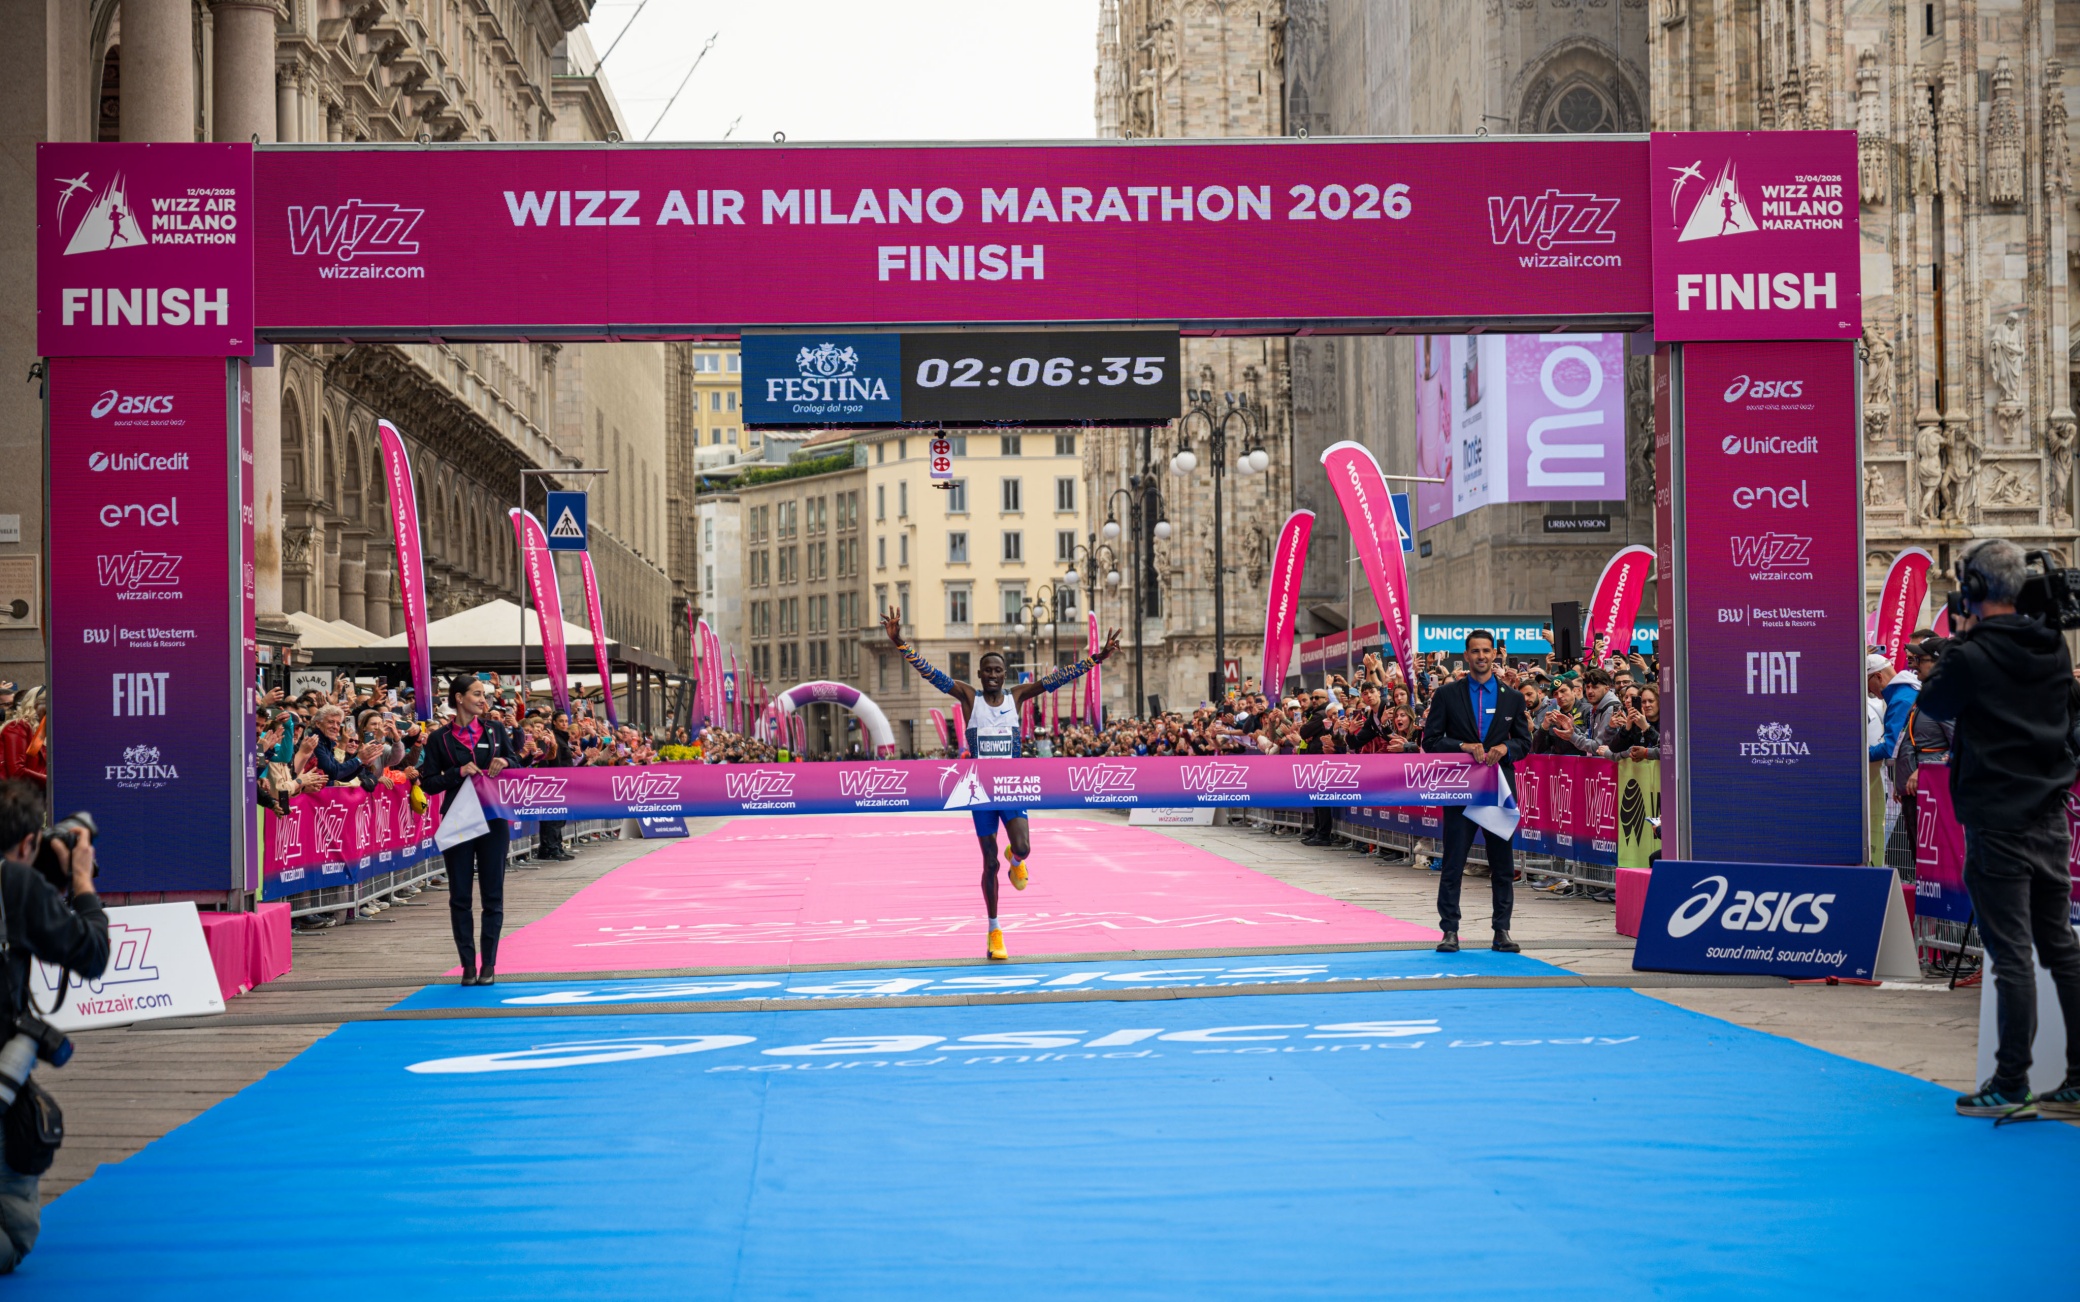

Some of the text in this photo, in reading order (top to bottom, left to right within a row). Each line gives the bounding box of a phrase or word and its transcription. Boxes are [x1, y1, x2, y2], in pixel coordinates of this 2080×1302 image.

[186, 188, 236, 196] 12/04/2026
[1761, 185, 1842, 198] WIZZ AIR
[151, 198, 236, 212] WIZZ AIR
[503, 183, 1412, 226] WIZZ AIR MILANO MARATHON 2026
[1762, 200, 1844, 216] MILANO
[151, 214, 237, 230] MILANO
[1762, 218, 1843, 230] MARATHON
[151, 233, 236, 245] MARATHON
[877, 244, 1044, 282] FINISH
[1518, 252, 1622, 268] wizzair.com
[318, 263, 425, 280] wizzair.com
[1677, 272, 1837, 311] FINISH
[62, 287, 229, 326] FINISH
[915, 356, 1166, 388] 02:06:35
[766, 378, 890, 401] FESTINA
[792, 402, 863, 415] Orologi dal 1902
[1526, 333, 1605, 487] mo
[1743, 436, 1819, 454] UniCredit
[111, 452, 190, 471] UniCredit
[1733, 479, 1809, 509] enel
[100, 496, 180, 527] enel
[1548, 519, 1606, 529] URBAN VISION
[1285, 525, 1301, 592] MARATHON
[1749, 571, 1814, 581] wizzair.com
[116, 590, 183, 601] wizzair.com
[1604, 563, 1631, 635] MARATHON
[1893, 565, 1912, 636] MARATHON
[1718, 608, 1743, 623] BW
[1753, 608, 1778, 619] Best
[83, 628, 110, 643] BW
[120, 628, 146, 640] Best
[1424, 627, 1510, 641] UNICRDIT
[1746, 651, 1801, 695] FIAT
[296, 675, 327, 687] MILANO
[112, 672, 170, 717] FIAT
[1740, 742, 1811, 756] FESTINA
[105, 765, 179, 780] FESTINA
[993, 775, 1041, 784] WIZZ AIR
[993, 784, 1042, 794] MILANO
[1309, 791, 1362, 802] wizzair.com
[1419, 790, 1473, 801] wizzair.com
[741, 799, 796, 810] wizzair.com
[855, 796, 909, 807] wizzair.com
[993, 794, 1041, 802] MARATHON
[1084, 793, 1138, 803] wizzair.com
[1196, 792, 1251, 802] wizzair.com
[513, 806, 568, 816] wizzair.com
[628, 803, 682, 813] wizzair.com
[1158, 815, 1194, 823] wizzair.com
[1915, 877, 1941, 899] air.com
[1721, 890, 1836, 934] asics
[1706, 945, 1848, 968] sound mind, sound body
[76, 991, 173, 1016] wizzair.com
[703, 1055, 948, 1073] sound
[1193, 1041, 1426, 1055] sound
[1448, 1035, 1640, 1049] body
